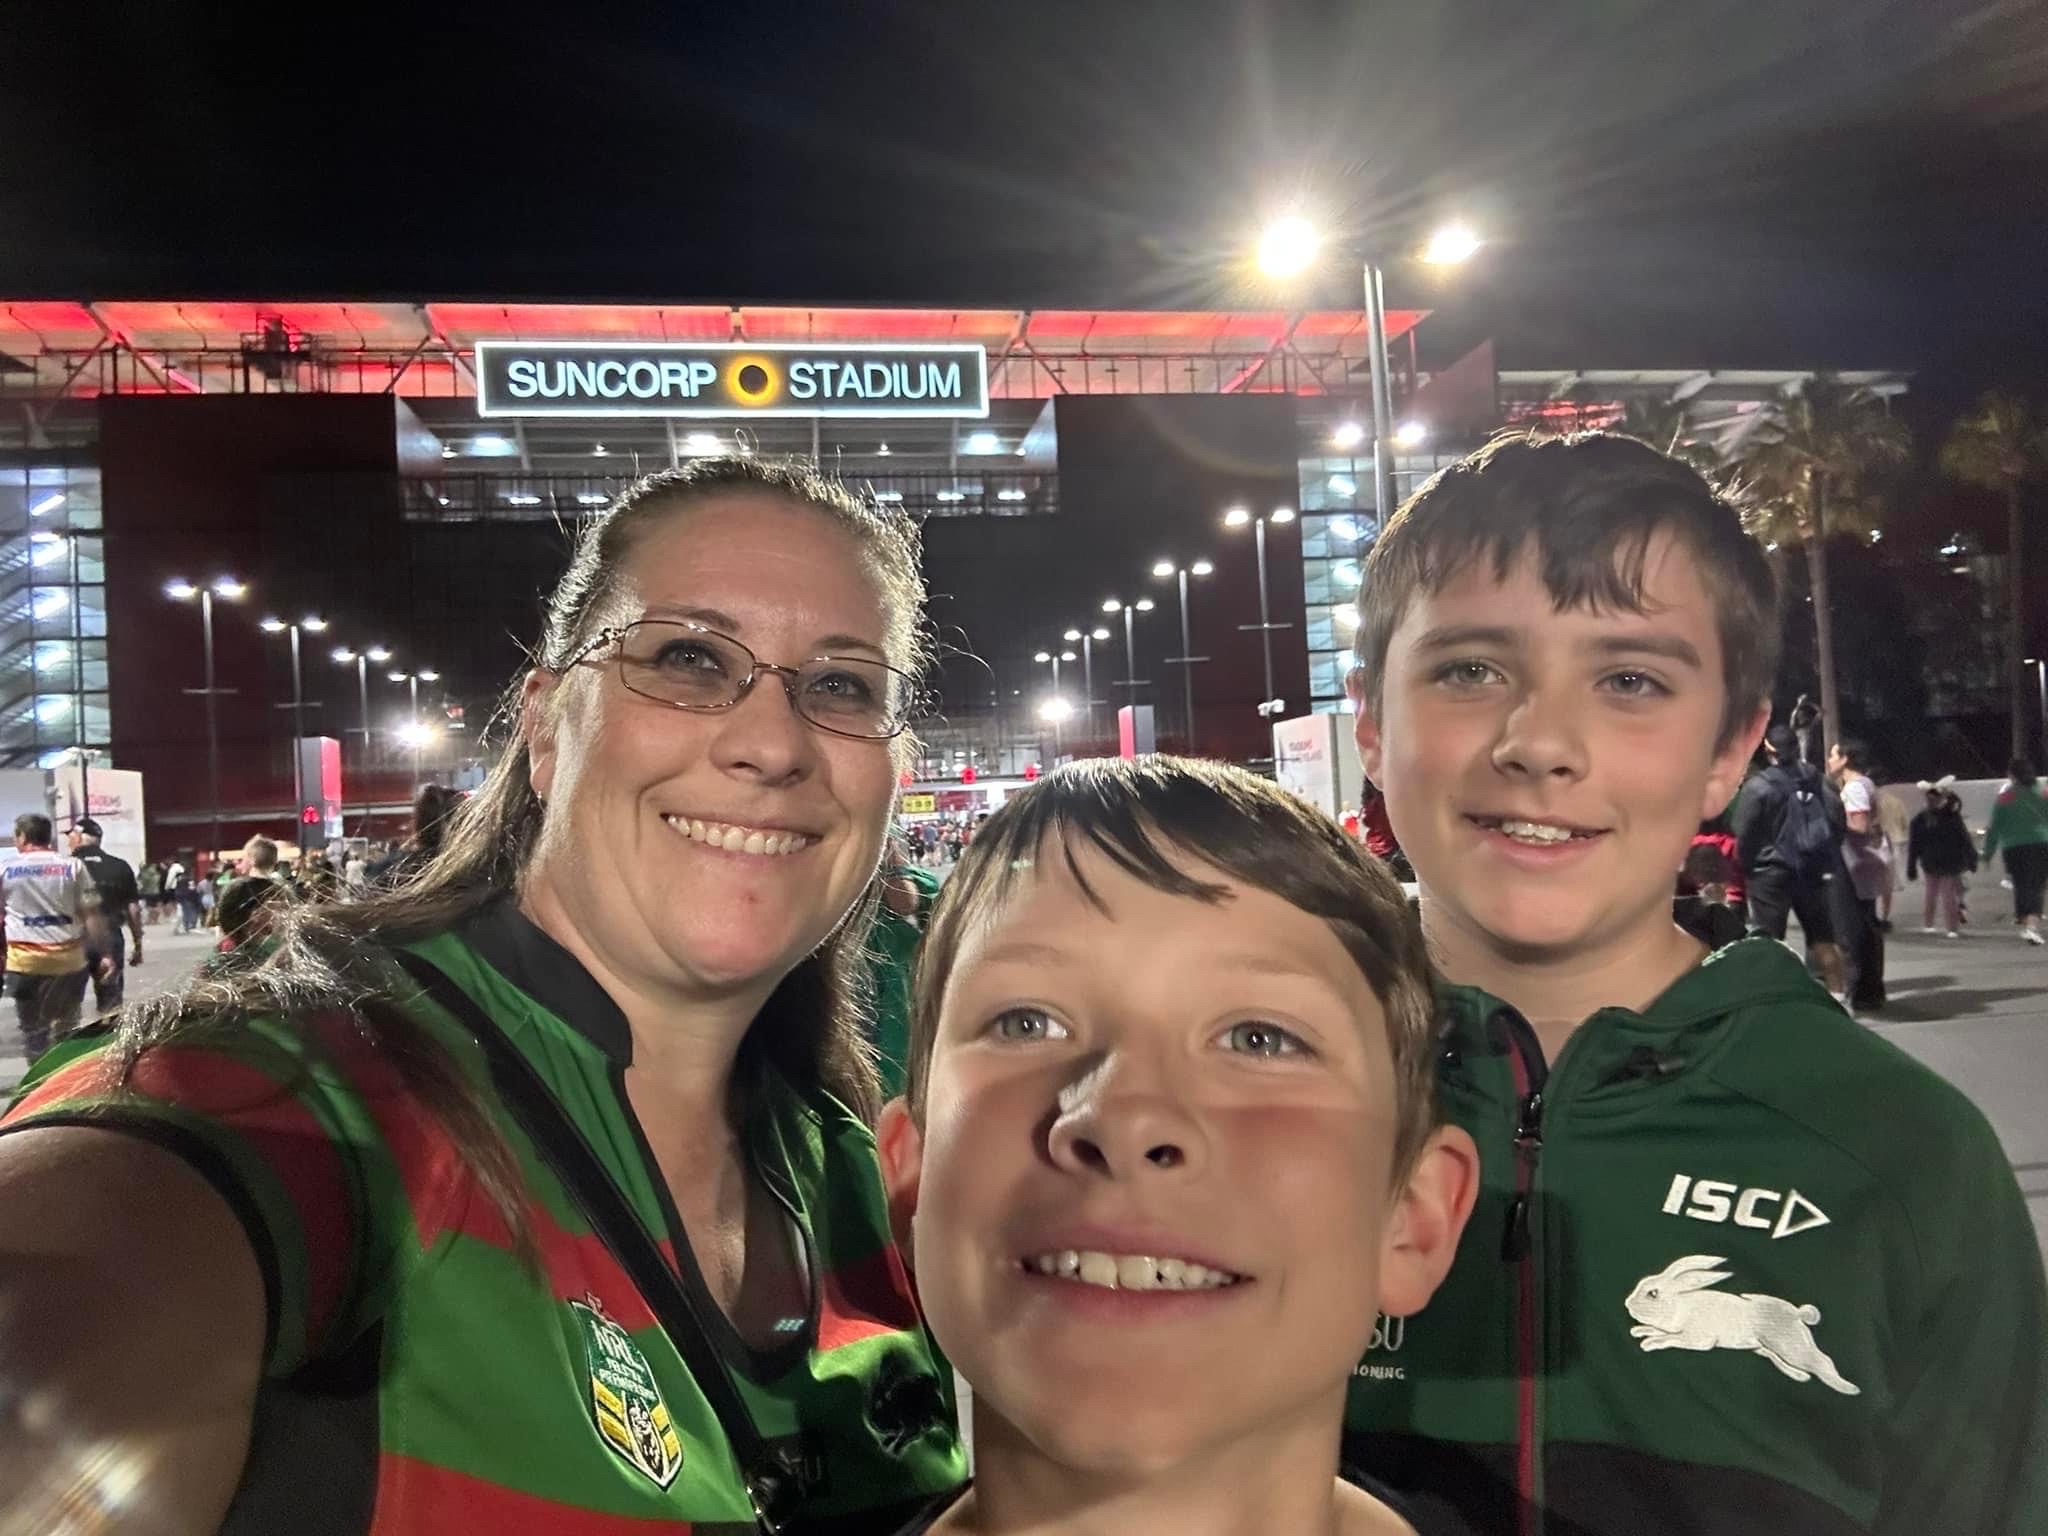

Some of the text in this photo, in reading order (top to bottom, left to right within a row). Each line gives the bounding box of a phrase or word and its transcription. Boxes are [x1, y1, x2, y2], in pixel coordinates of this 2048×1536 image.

[507, 360, 962, 400] SUNCORP STADIUM
[1662, 1173, 1781, 1230] ISC
[590, 1319, 645, 1373] NRL
